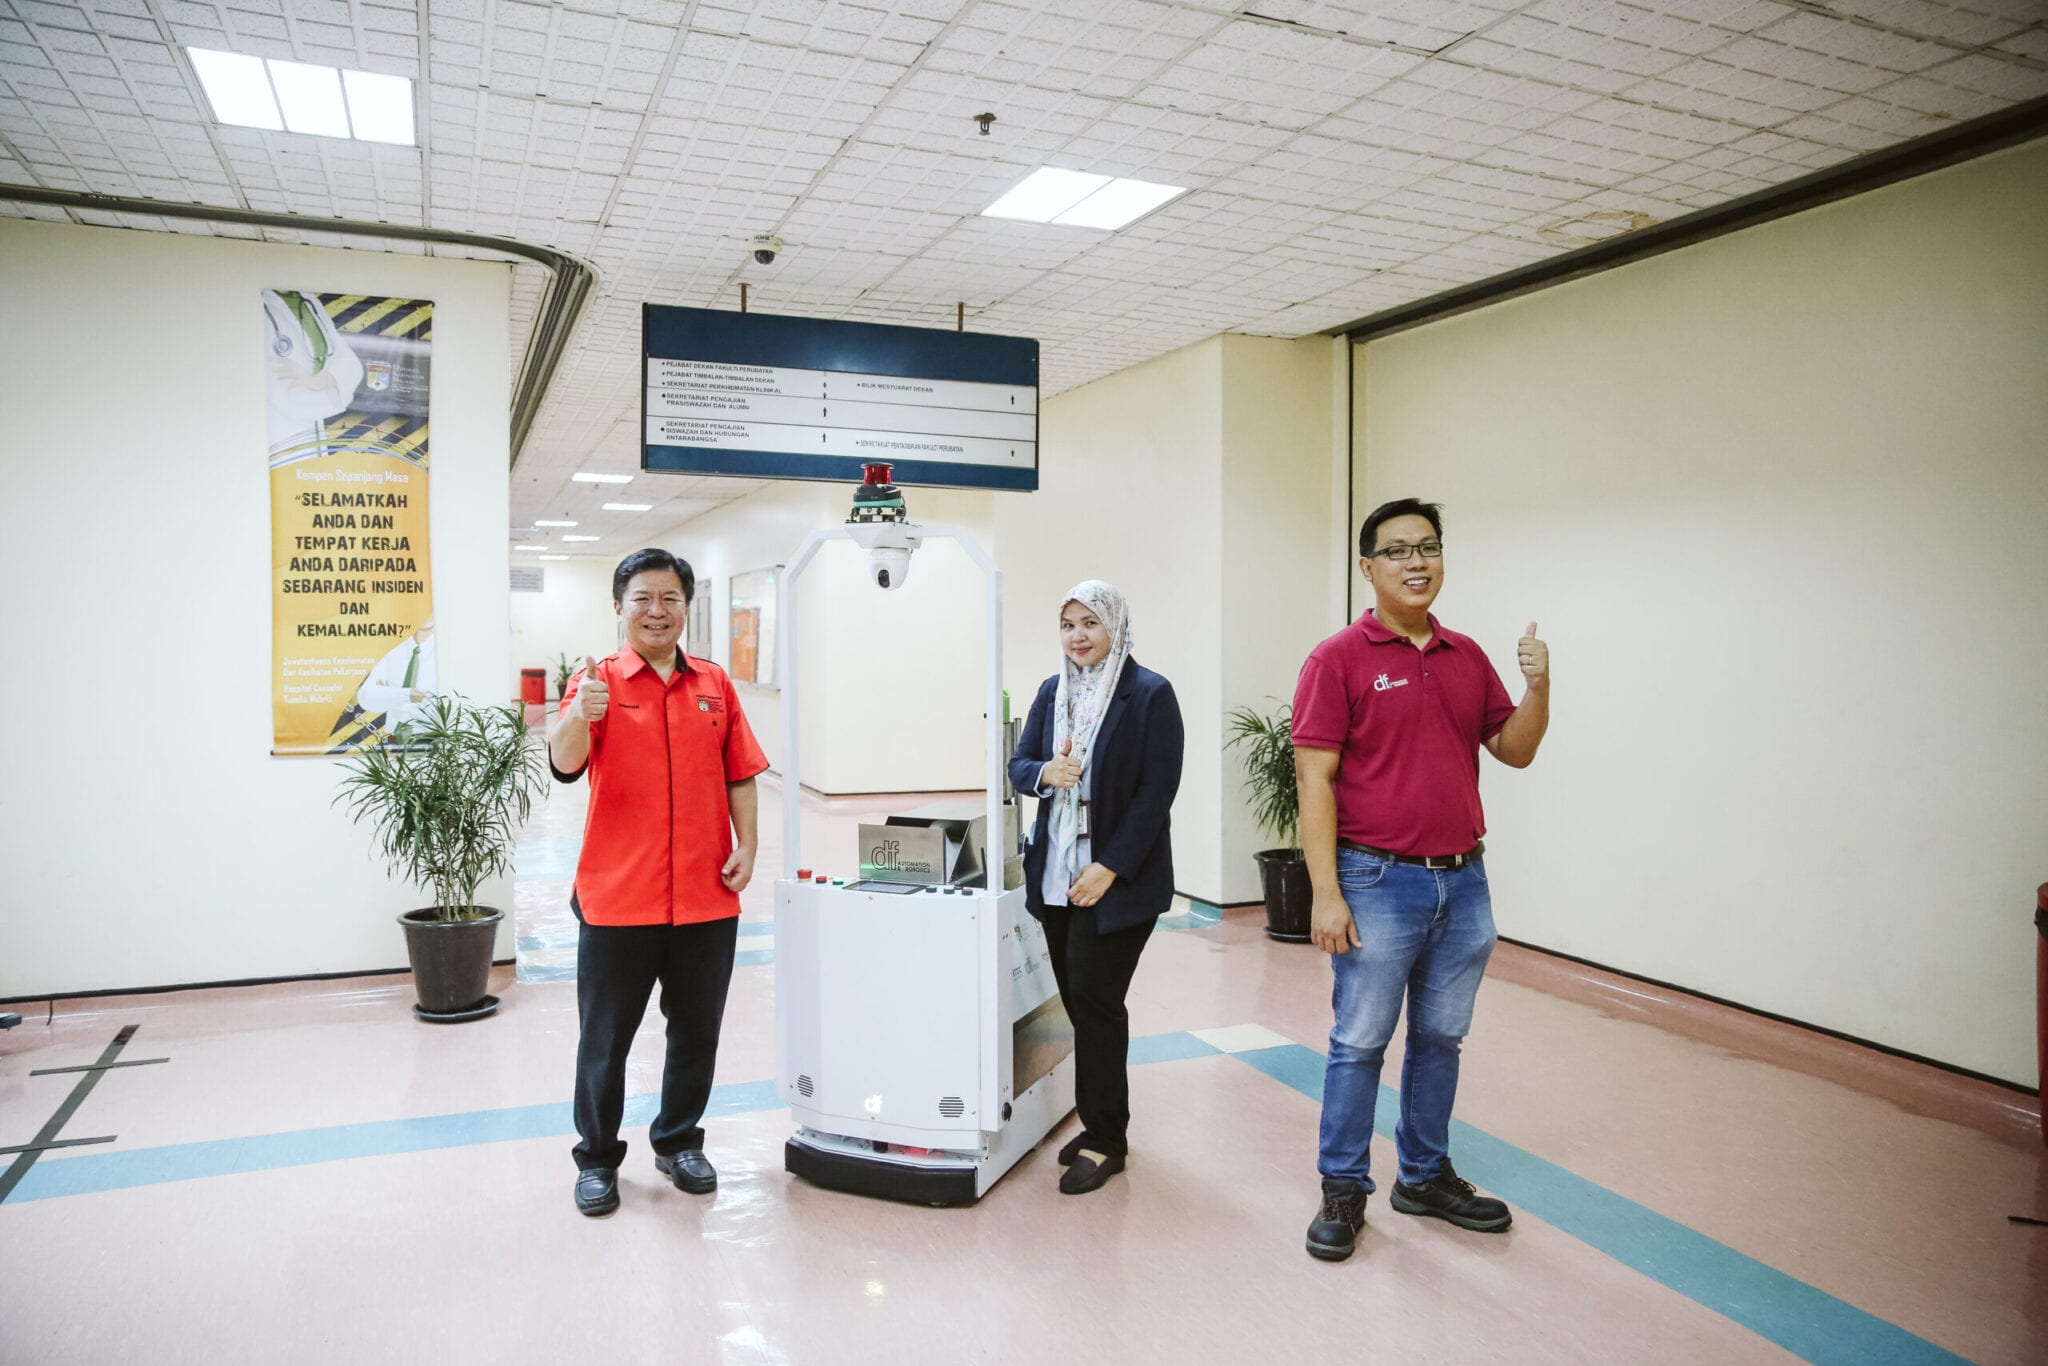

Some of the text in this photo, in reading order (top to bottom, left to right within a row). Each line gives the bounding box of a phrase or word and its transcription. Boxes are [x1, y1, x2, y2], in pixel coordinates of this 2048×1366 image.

[709, 384, 755, 392] PERKHIDMATAN
[666, 400, 712, 408] PRASISWAZAH
[667, 393, 709, 401] SEKRETARIAT
[385, 470, 409, 484] Masa
[312, 514, 393, 529] ANDA DAN
[295, 536, 410, 551] TEMPAT KERJA
[289, 557, 417, 572] ANDA DARIPADA
[282, 578, 424, 594] SEBARANG INSIDEN
[339, 602, 369, 615] DAN
[871, 840, 899, 871] df
